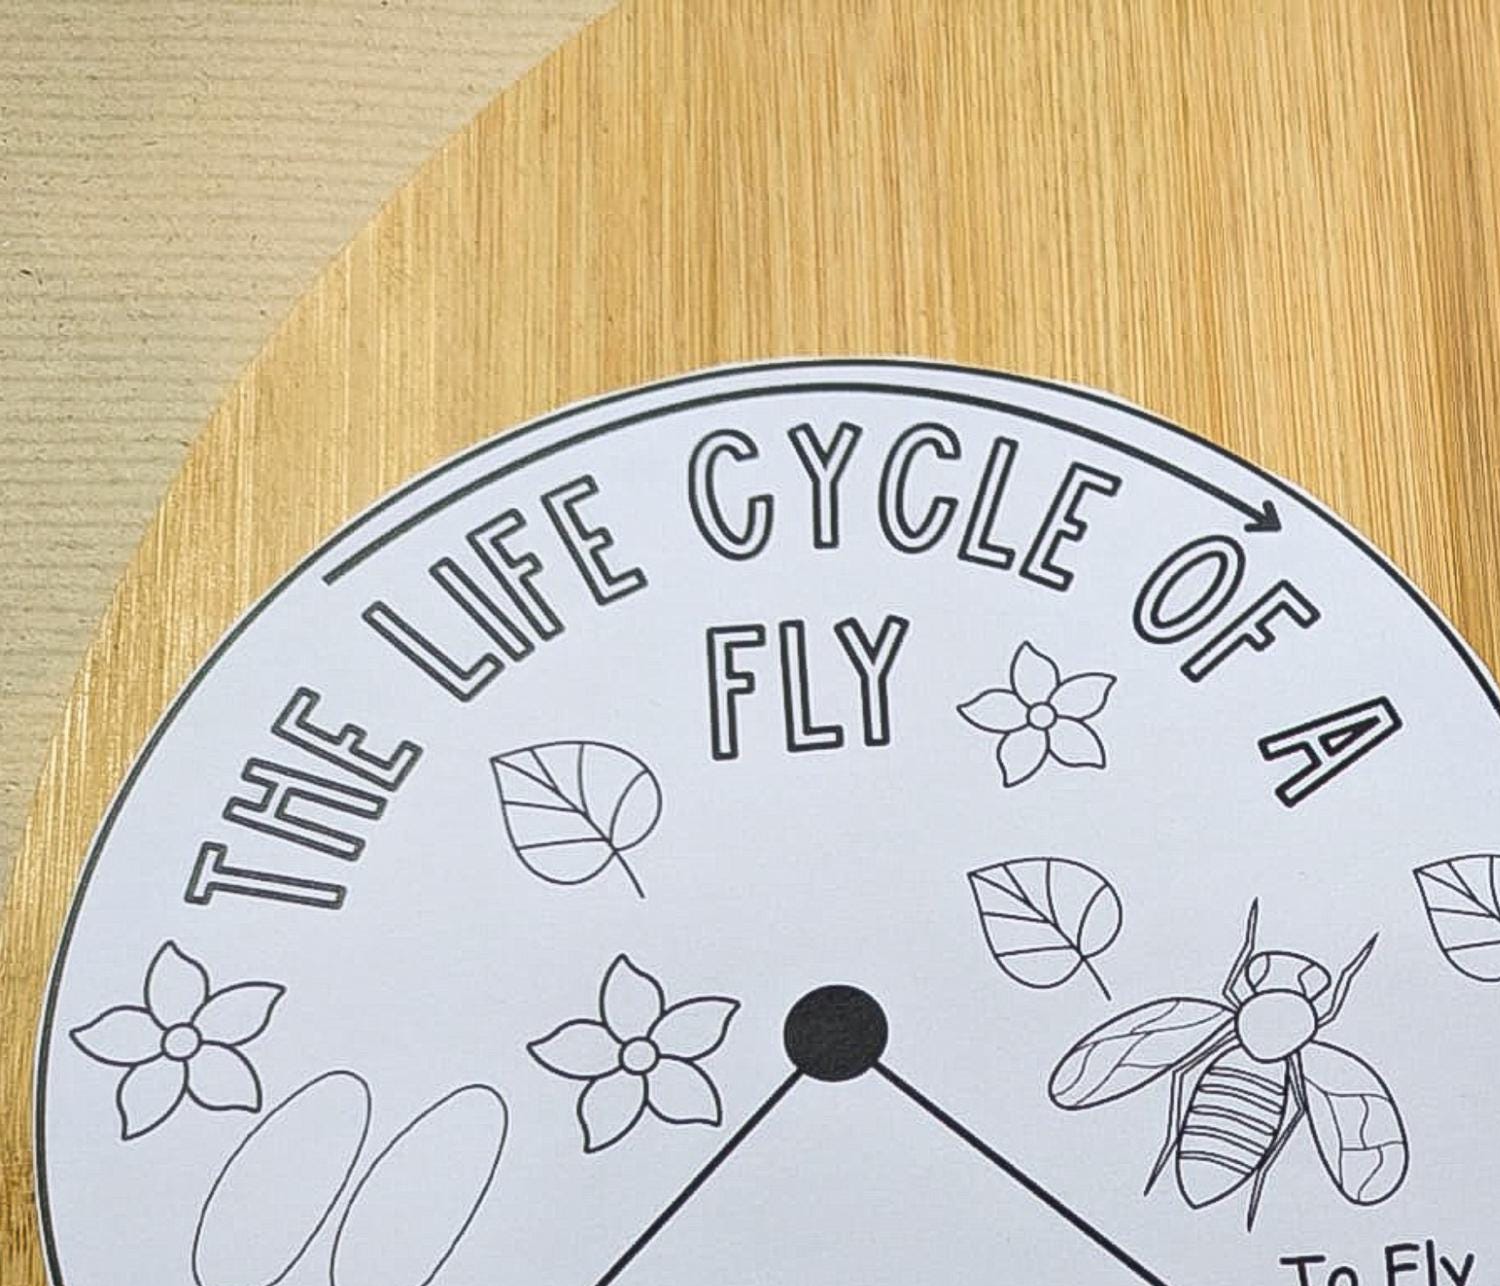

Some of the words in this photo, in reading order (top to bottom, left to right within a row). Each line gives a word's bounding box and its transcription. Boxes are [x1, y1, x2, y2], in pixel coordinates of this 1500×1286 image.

[184, 686, 423, 909] THE
[361, 475, 648, 702] LIFE
[688, 422, 1121, 591] CYCLE
[1132, 534, 1322, 682] OF
[1258, 695, 1403, 807] A
[706, 615, 910, 761] FLY
